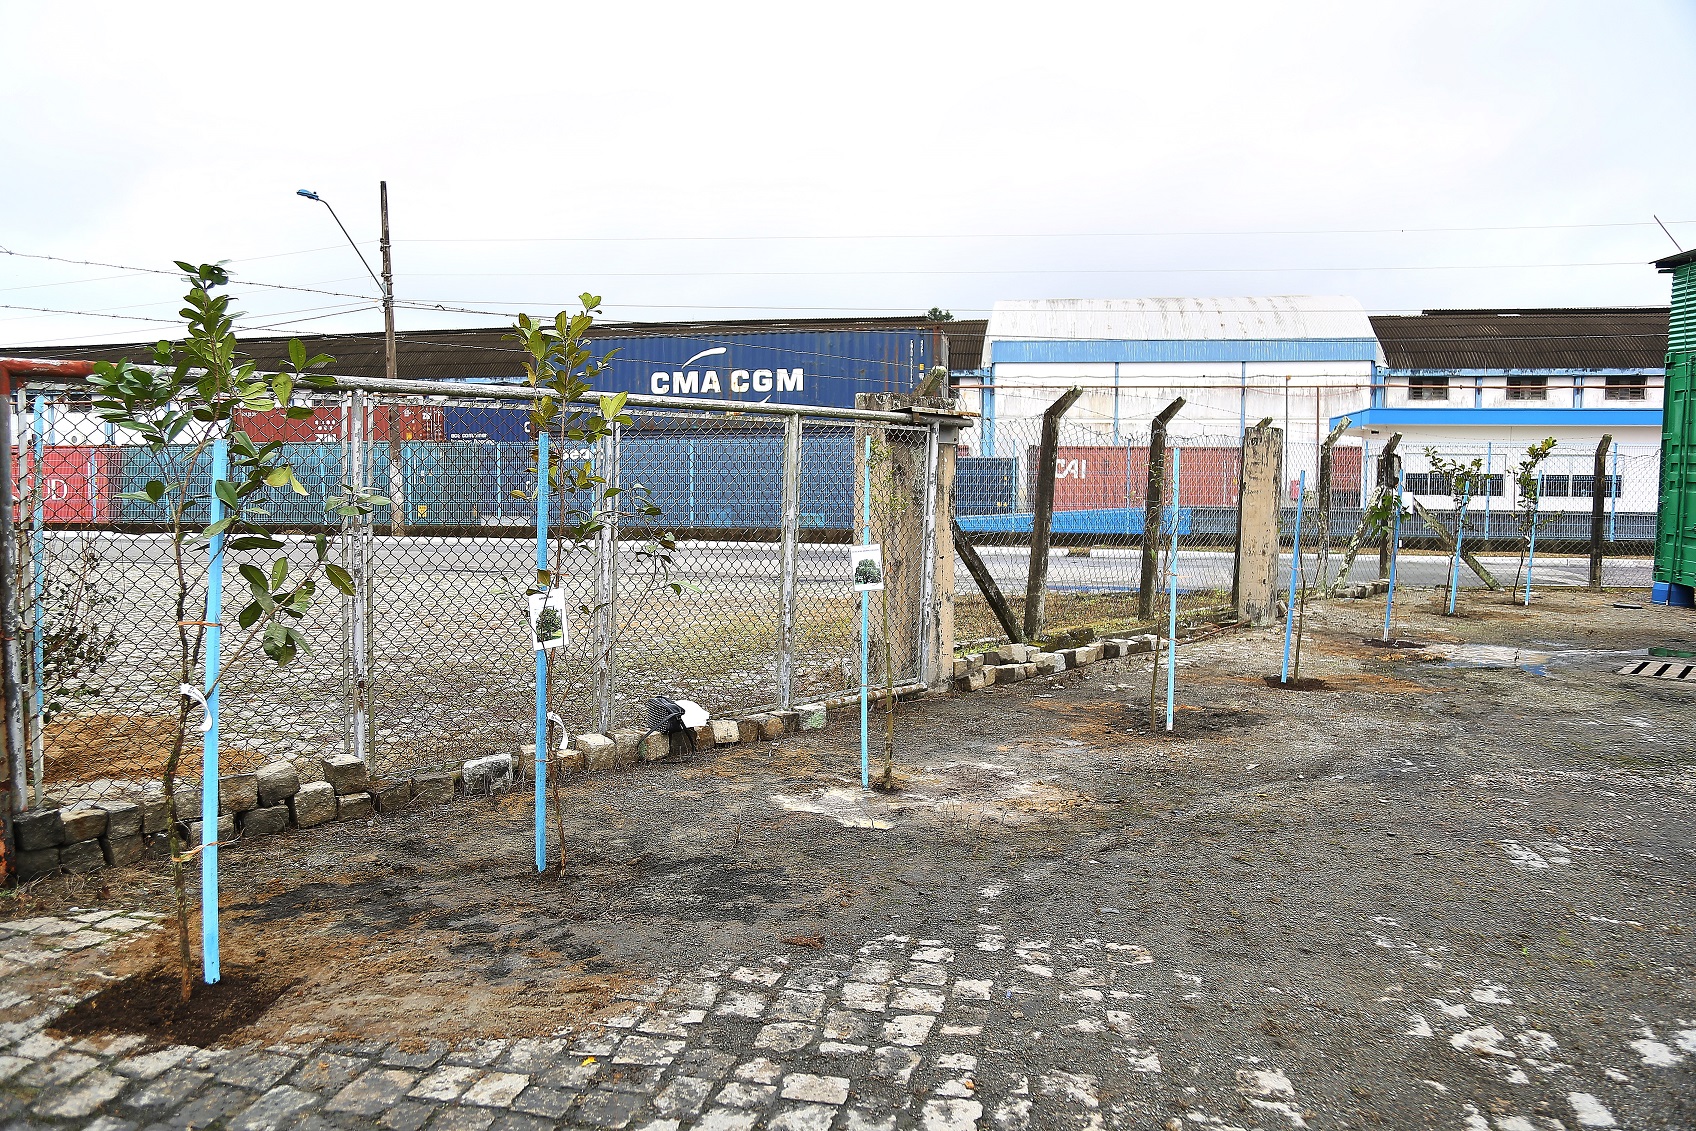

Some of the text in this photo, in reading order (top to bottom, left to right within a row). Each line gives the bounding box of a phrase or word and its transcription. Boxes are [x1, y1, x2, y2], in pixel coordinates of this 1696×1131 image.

[650, 368, 805, 395] CMA CGM
[1055, 458, 1087, 479] CAI
